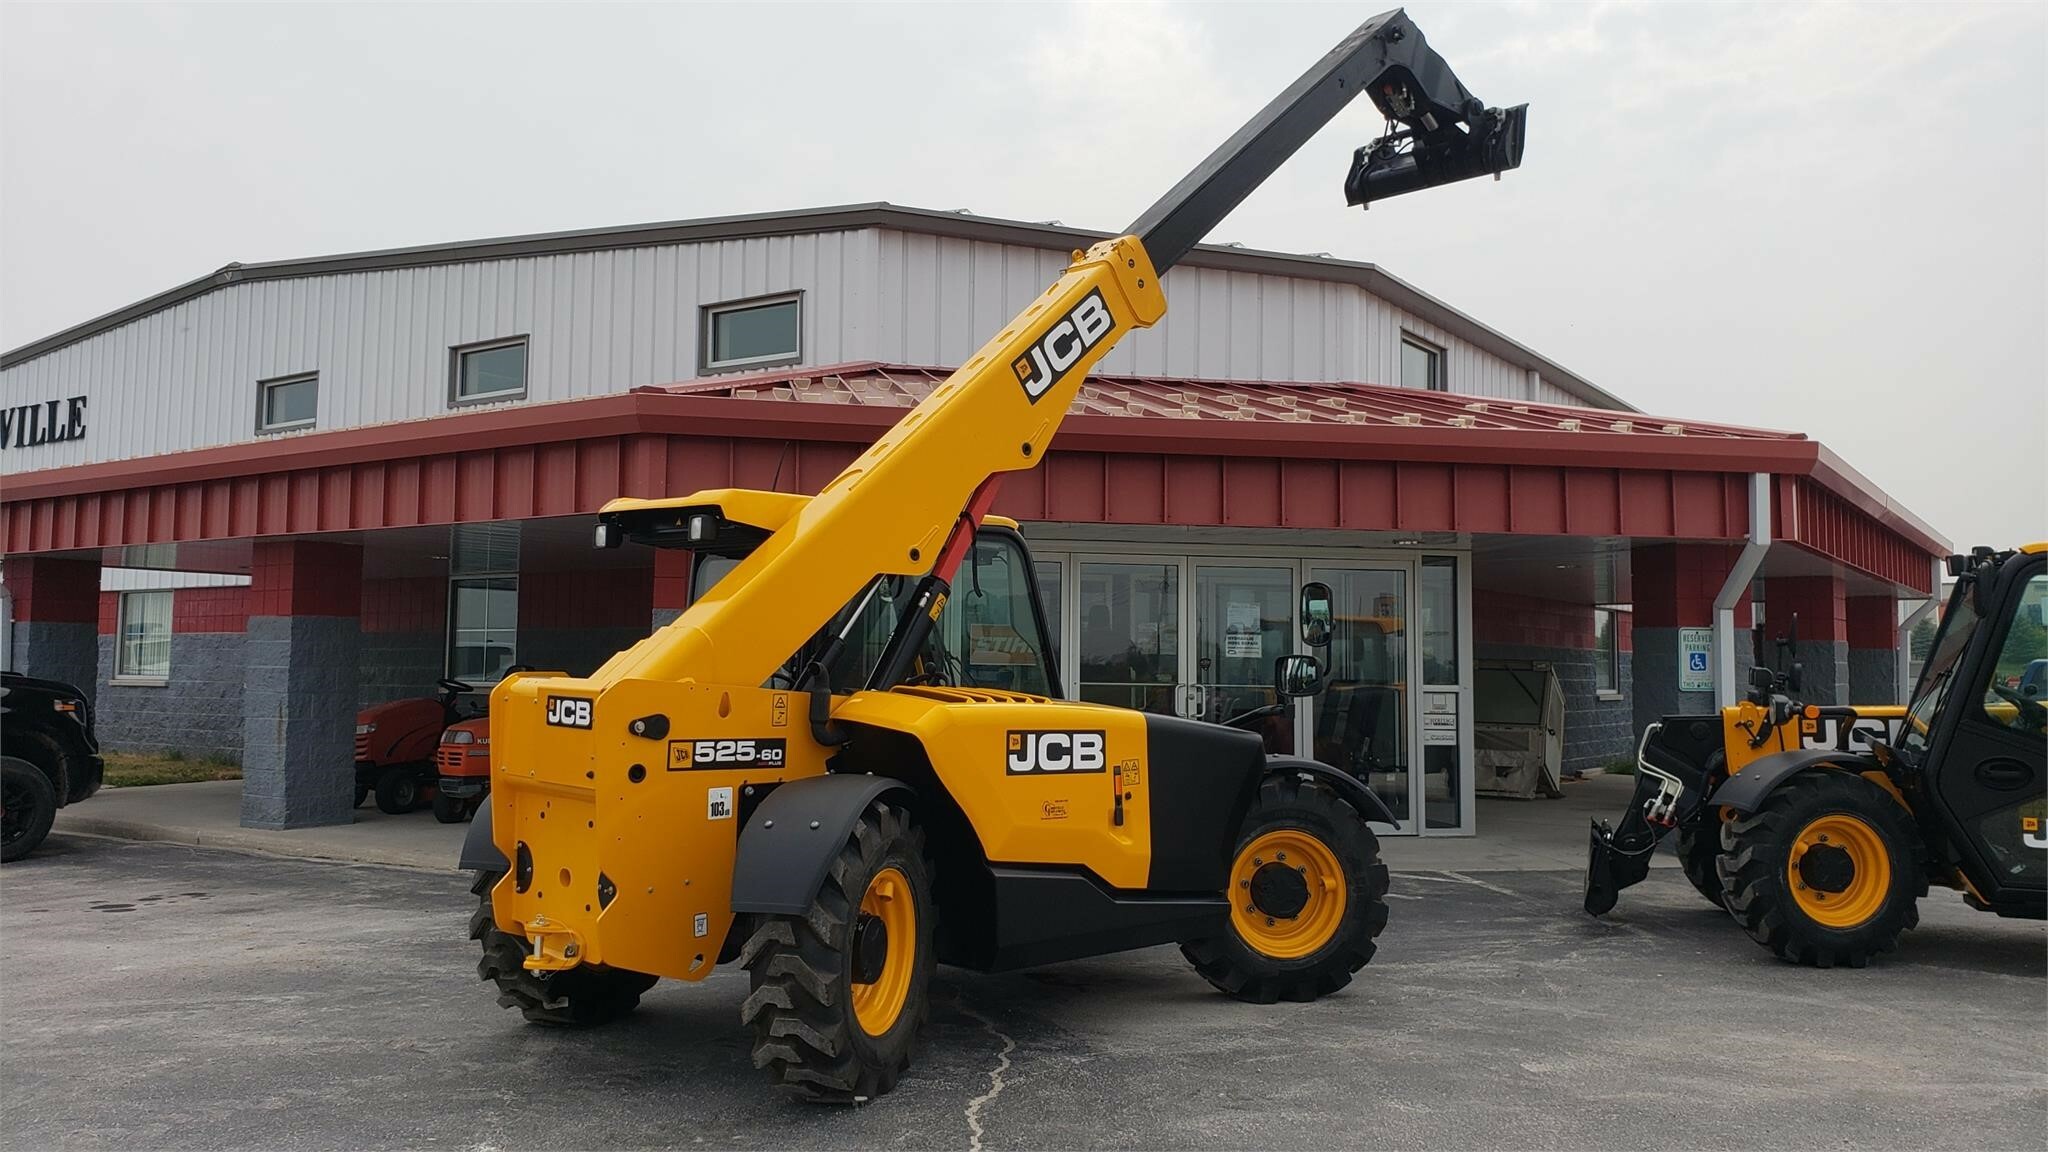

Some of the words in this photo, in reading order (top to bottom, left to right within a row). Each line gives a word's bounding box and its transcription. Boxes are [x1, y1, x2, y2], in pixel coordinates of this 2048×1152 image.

[1025, 295, 1111, 396] JCB
[0, 395, 87, 450] VILLE
[548, 699, 591, 726] JCB
[694, 741, 783, 762] 525-60
[1008, 733, 1104, 771] JCB
[710, 802, 725, 817] 103
